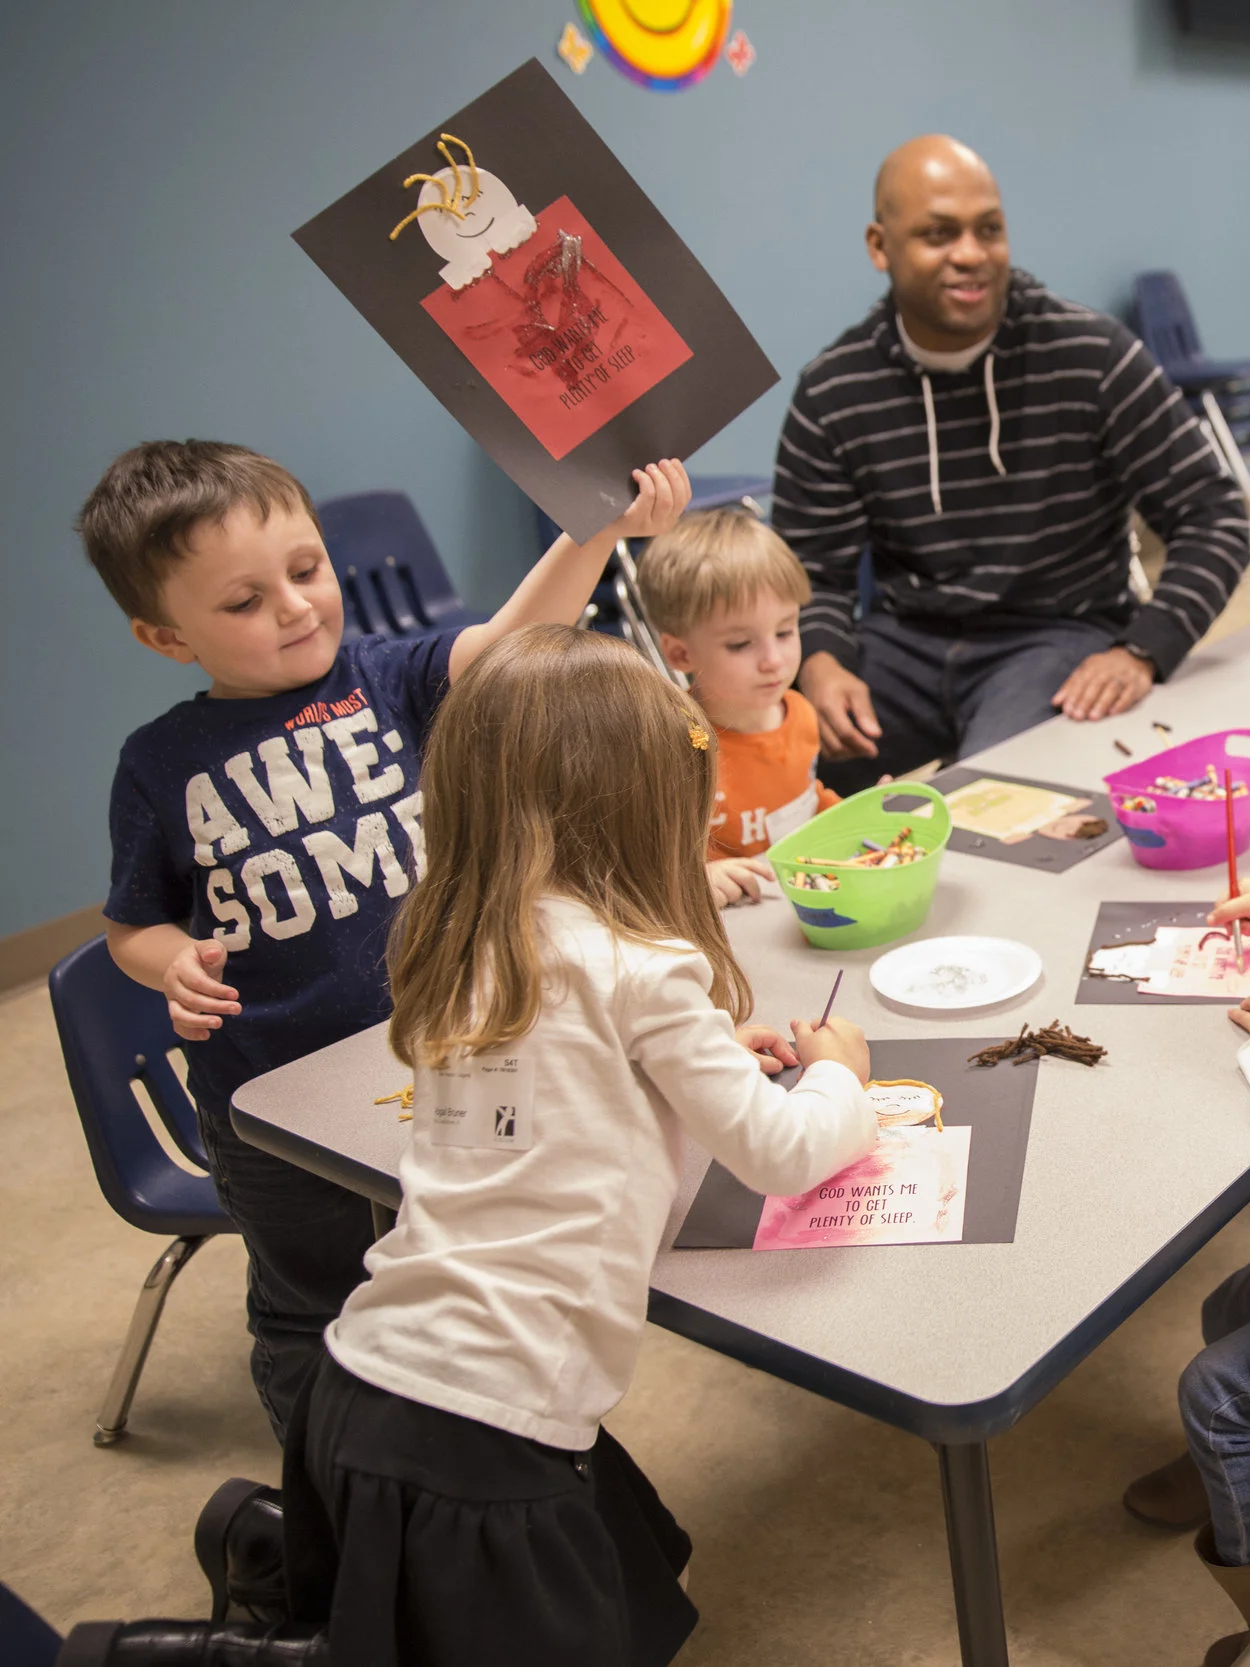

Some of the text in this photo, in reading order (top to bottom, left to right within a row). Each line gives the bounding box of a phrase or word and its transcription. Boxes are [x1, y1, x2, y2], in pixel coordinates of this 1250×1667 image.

[529, 306, 608, 371] GOD WANTS ME
[566, 341, 603, 373] TO GET
[559, 373, 598, 410] PLENTY
[595, 365, 611, 383] OF
[329, 688, 368, 717] MOST
[819, 1183, 918, 1200] GOD WANTS ME
[845, 1199, 887, 1213] TO GET
[809, 1212, 916, 1229] PLENTY OF SLEEP.
